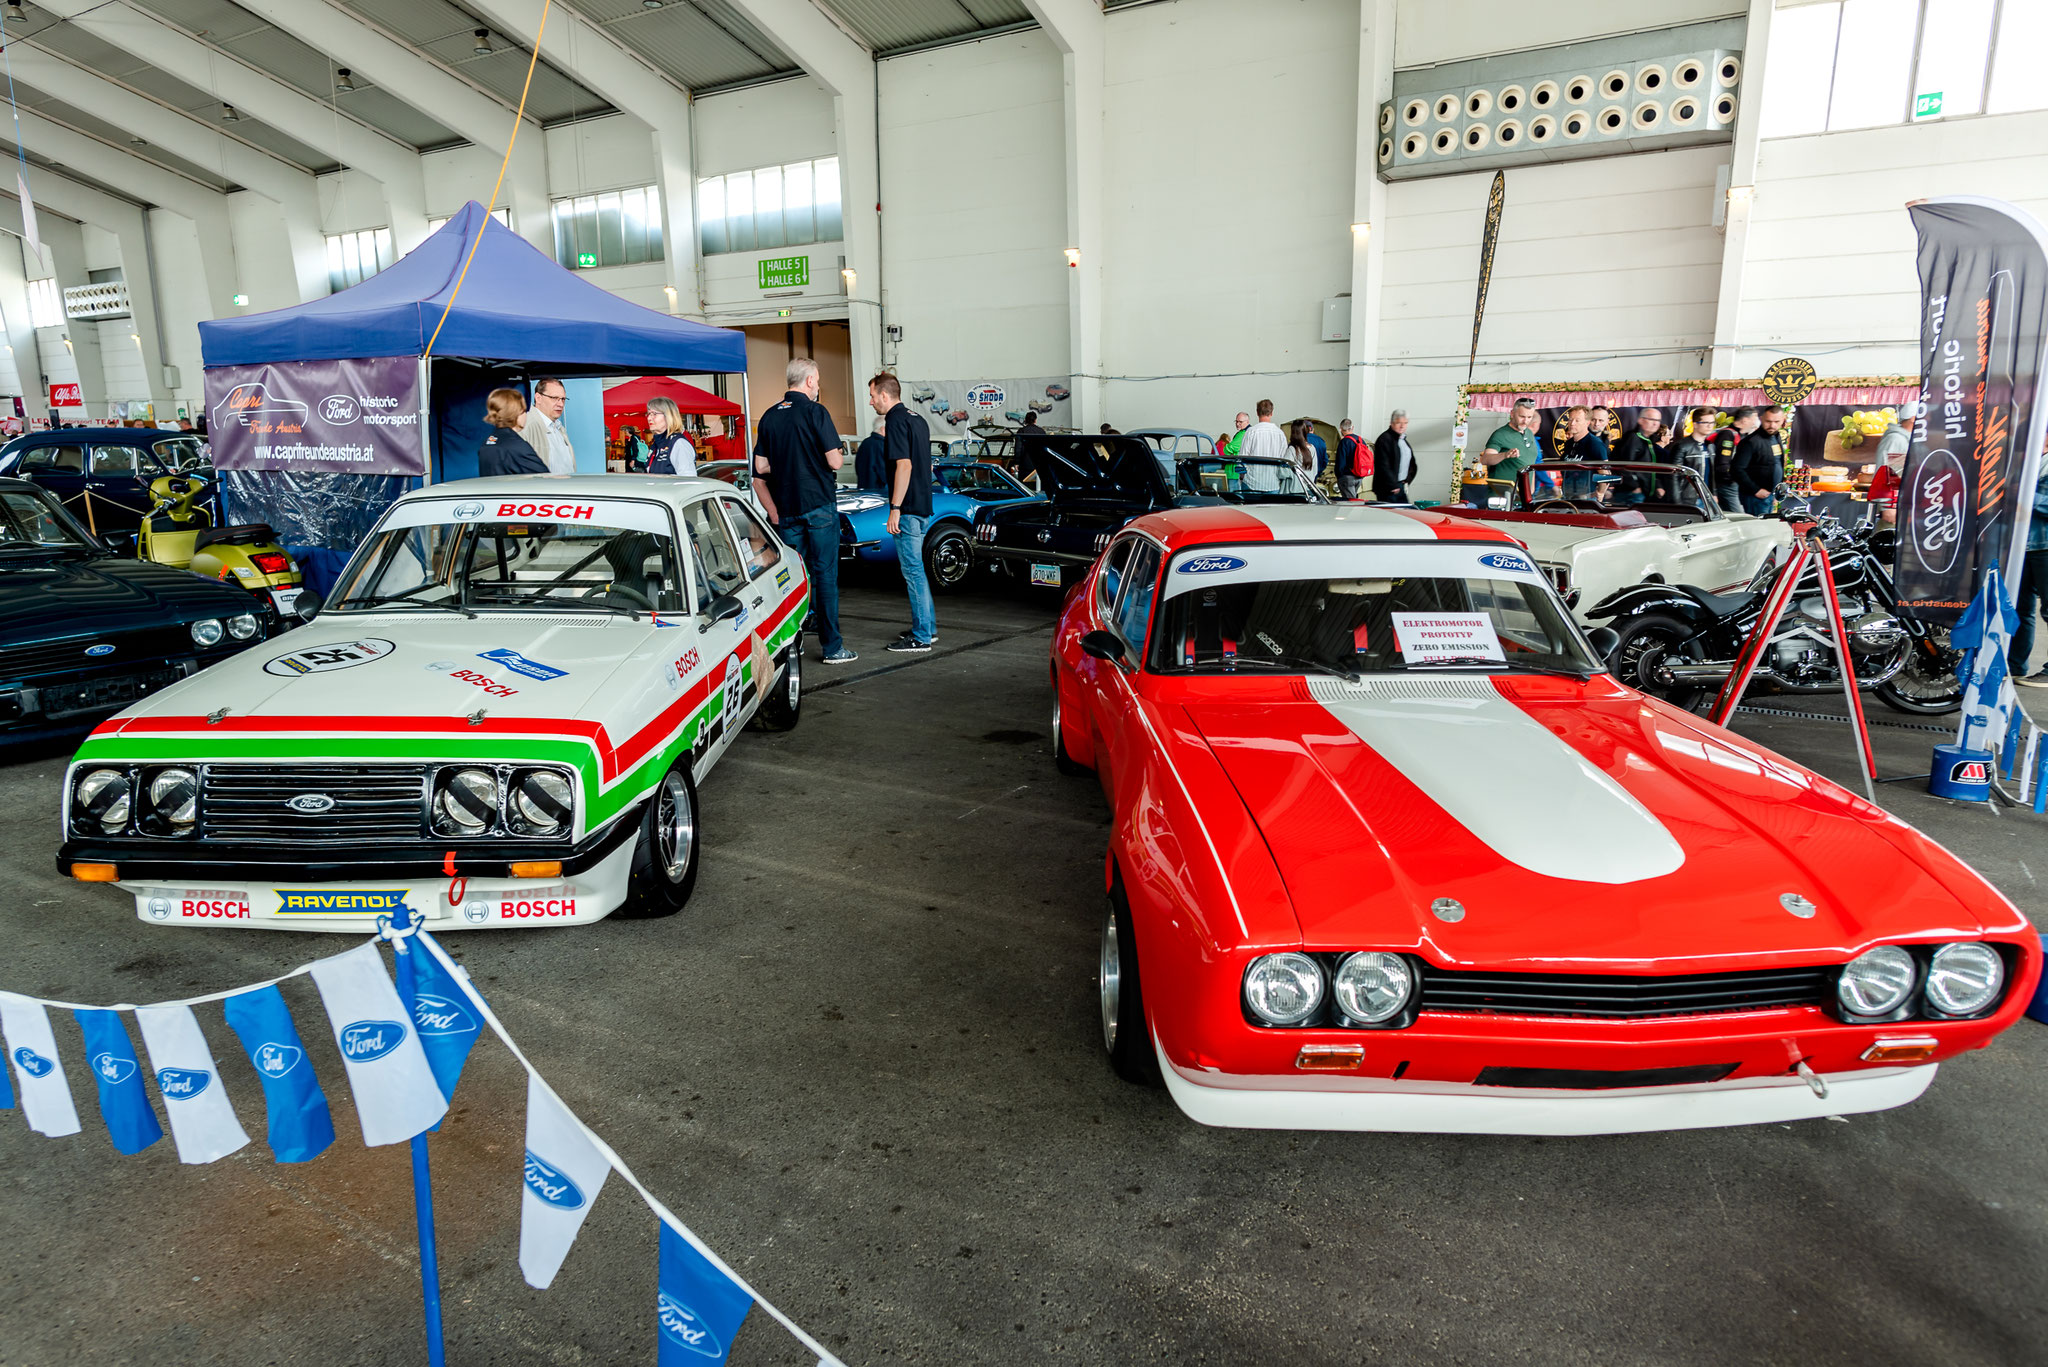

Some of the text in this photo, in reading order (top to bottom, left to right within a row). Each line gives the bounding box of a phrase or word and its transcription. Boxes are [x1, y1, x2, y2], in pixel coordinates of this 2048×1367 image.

[767, 258, 801, 271] HALLE 5
[767, 273, 801, 286] HALLE 6
[326, 398, 353, 420] Ford
[359, 395, 398, 408] historic
[363, 413, 417, 428] motorsport
[497, 504, 594, 520] BOSCH
[1189, 556, 1232, 572] Ford
[1492, 555, 1528, 571] Ford
[1402, 620, 1484, 628] ELEKTROMOTOR
[1420, 631, 1473, 639] PROTOTYP
[1256, 631, 1283, 656] sparco
[1411, 643, 1490, 651] ZERO EMISSION
[675, 646, 701, 679] BOSCH
[449, 669, 519, 697] BOSCH
[300, 797, 324, 809] Ford
[182, 900, 250, 919] BOSCH
[288, 895, 397, 909] RAVENOL
[501, 899, 576, 919] BOSCH
[345, 1027, 387, 1056] Ford
[162, 1072, 194, 1093] Ford
[658, 1293, 706, 1345] Ford
